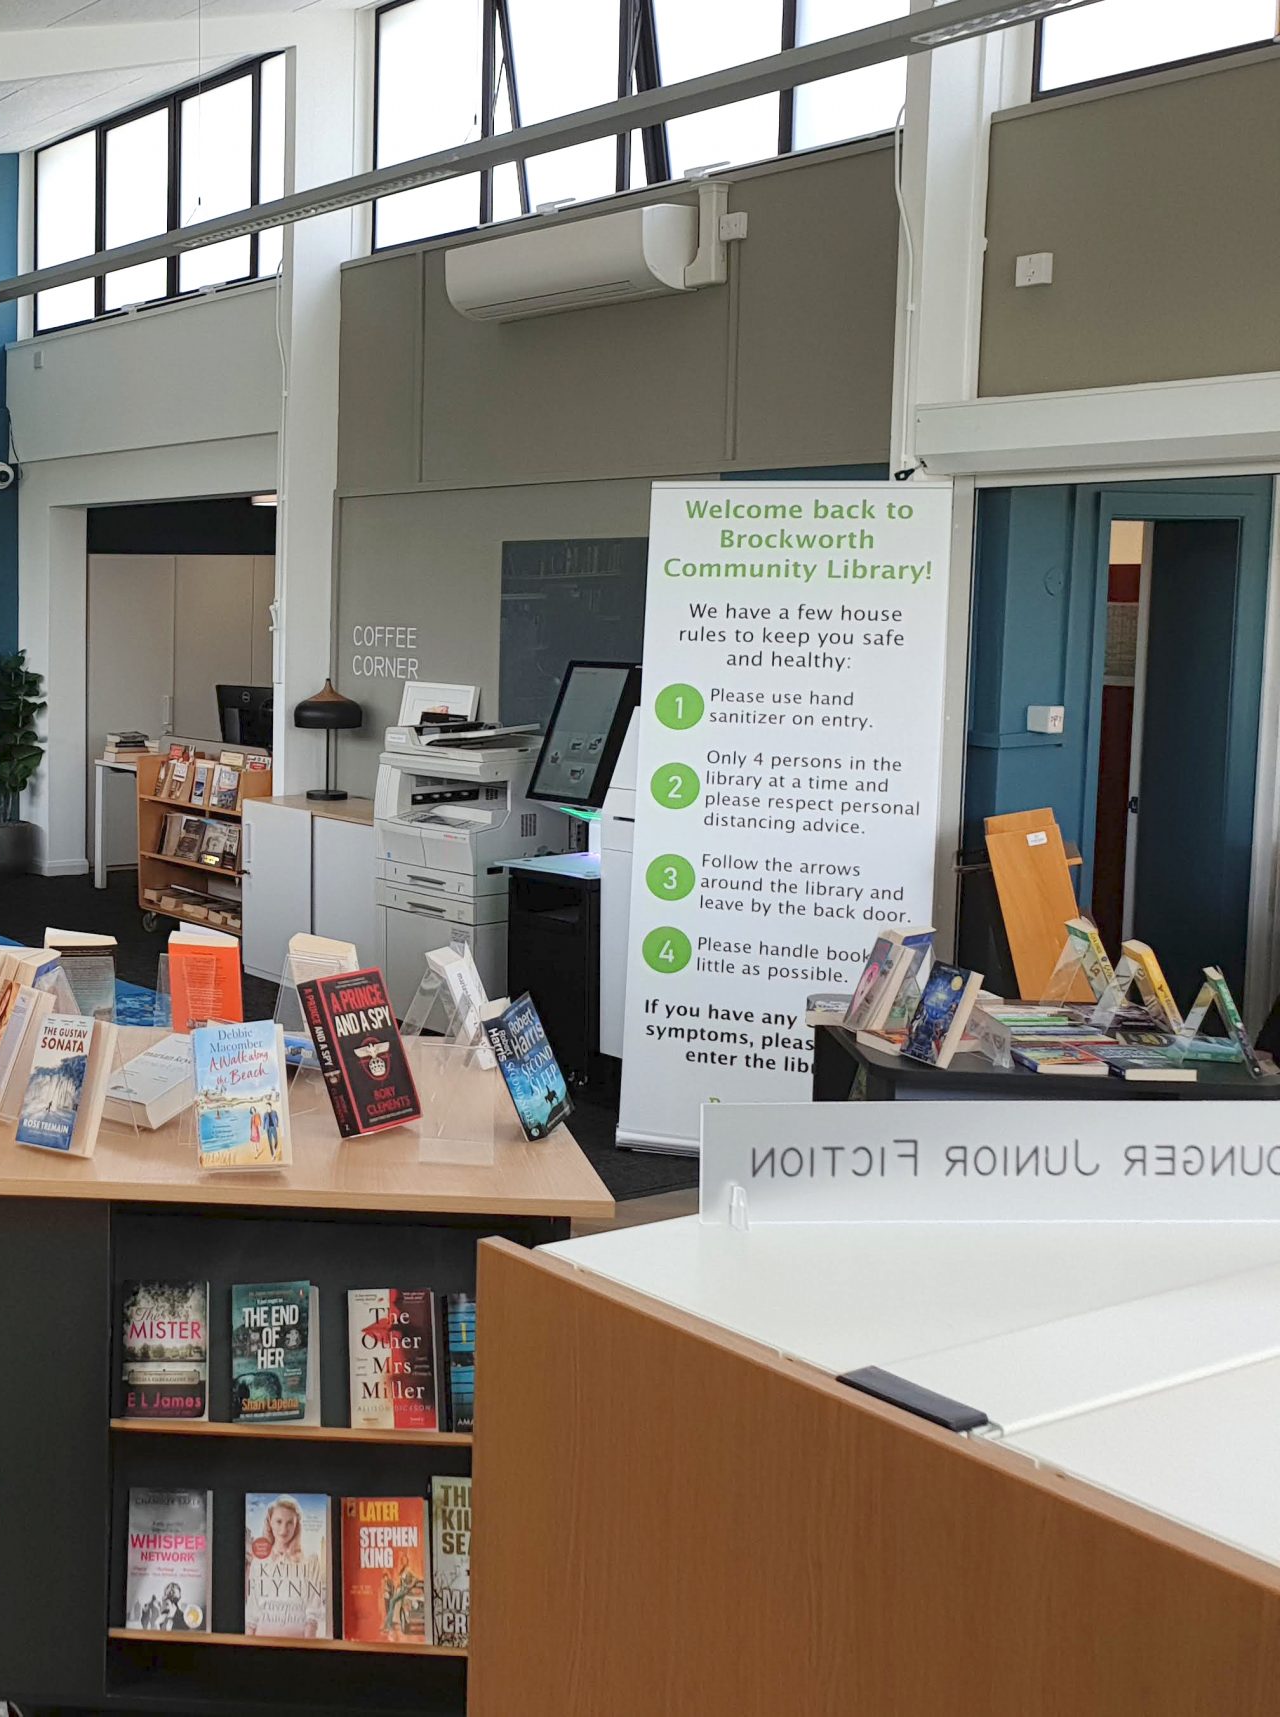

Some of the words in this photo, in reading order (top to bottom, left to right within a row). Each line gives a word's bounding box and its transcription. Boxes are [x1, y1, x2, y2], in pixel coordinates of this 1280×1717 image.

[686, 499, 803, 520] Welcome
[813, 499, 875, 520] back
[887, 502, 914, 520] to
[720, 529, 875, 549] Brockworth
[664, 558, 817, 583] Community
[828, 560, 932, 584] Library!
[689, 603, 717, 619] We
[726, 603, 771, 620] have
[779, 608, 789, 620] a
[798, 604, 833, 621] few
[841, 605, 902, 622] house
[353, 626, 417, 648] COFFEE
[679, 626, 726, 642] rules
[735, 629, 754, 643] to
[763, 627, 810, 645] keep
[818, 631, 854, 647] you
[862, 629, 904, 646] safe
[352, 655, 418, 679] CORNER
[726, 651, 762, 666] and
[772, 652, 851, 672] healthy:
[675, 696, 683, 719] 1
[711, 688, 764, 704] Please
[772, 692, 802, 704] use
[810, 691, 854, 706] hand
[709, 710, 786, 725] sanitizer
[792, 714, 814, 726] on
[822, 715, 873, 730] entry.
[707, 750, 747, 768] Only
[753, 752, 763, 765] 4
[771, 755, 842, 770] persons
[850, 756, 865, 770] in
[874, 757, 902, 772] the
[668, 775, 682, 798] 2
[706, 770, 762, 788] library
[769, 773, 785, 788] at
[791, 777, 801, 789] a
[808, 774, 847, 791] time
[855, 777, 889, 793] and
[705, 793, 760, 808] please
[768, 797, 834, 812] respect
[841, 801, 920, 816] personal
[704, 813, 795, 833] distancing
[803, 818, 866, 834] advice.
[702, 854, 758, 871] Follow
[765, 858, 792, 873] the
[800, 862, 860, 877] arrows
[662, 867, 678, 890] 3
[700, 875, 762, 892] around
[770, 879, 798, 894] the
[806, 881, 863, 901] library
[870, 886, 904, 901] and
[700, 896, 744, 911] leave
[752, 898, 771, 916] by
[779, 901, 806, 916] the
[814, 904, 855, 919] back
[863, 907, 911, 923] door.
[659, 940, 674, 963] 4
[698, 937, 752, 954] Please
[760, 941, 819, 959] handle
[827, 945, 870, 963] book
[697, 958, 735, 974] little
[742, 964, 760, 975] as
[768, 964, 848, 983] possible.
[306, 994, 322, 1025] PRINCE
[330, 992, 341, 1014] A
[340, 984, 385, 1012] PRINCE
[335, 1012, 360, 1038] AND
[360, 1011, 370, 1033] A
[370, 1005, 392, 1030] SPY
[507, 1007, 535, 1037] Robert
[644, 1000, 659, 1014] If
[665, 1004, 700, 1019] you
[708, 1004, 754, 1022] have
[762, 1010, 797, 1029] any
[44, 1026, 57, 1036] THE
[59, 1028, 88, 1039] GUSTAV
[218, 1028, 253, 1041] Debbie
[314, 1026, 322, 1043] AND
[499, 1029, 513, 1057] Robert
[509, 1022, 545, 1060] Harris
[646, 1023, 754, 1048] symptoms,
[761, 1028, 815, 1051] pleas
[41, 1037, 84, 1053] SONATA
[210, 1039, 264, 1054] Macomber
[319, 1043, 327, 1051] A
[488, 1028, 507, 1062] Harris
[209, 1058, 217, 1072] A
[220, 1053, 248, 1067] Walk
[249, 1050, 269, 1062] along
[322, 1051, 333, 1066] SPY
[521, 1044, 553, 1083] SECOND
[686, 1049, 737, 1067] enter
[745, 1053, 776, 1070] the
[216, 1075, 227, 1086] the
[230, 1064, 269, 1085] Beach
[528, 1064, 557, 1097] SLEEP
[373, 1086, 396, 1101] RORY
[366, 1095, 411, 1115] CLEMENTS
[23, 1118, 40, 1129] ROSE
[40, 1121, 69, 1134] TREMAIN
[242, 1306, 269, 1328] THE
[271, 1304, 299, 1326] END
[369, 1307, 410, 1325] The
[128, 1322, 202, 1339] MISTER
[262, 1326, 280, 1348] OF
[362, 1330, 422, 1350] Other
[257, 1348, 285, 1370] HER
[373, 1356, 412, 1374] Mrs
[128, 1392, 136, 1408] E
[142, 1392, 148, 1408] L
[153, 1392, 202, 1409] James
[362, 1380, 425, 1400] Miller
[242, 1398, 265, 1411] Shari
[268, 1398, 298, 1411] Lapena
[359, 1501, 400, 1522] LATER
[441, 1508, 471, 1531] KIL
[131, 1533, 207, 1551] WHISPER
[360, 1526, 418, 1548] STEPHEN
[141, 1551, 195, 1562] NETWORK
[360, 1548, 394, 1569] KING
[248, 1579, 322, 1598] FLYNN
